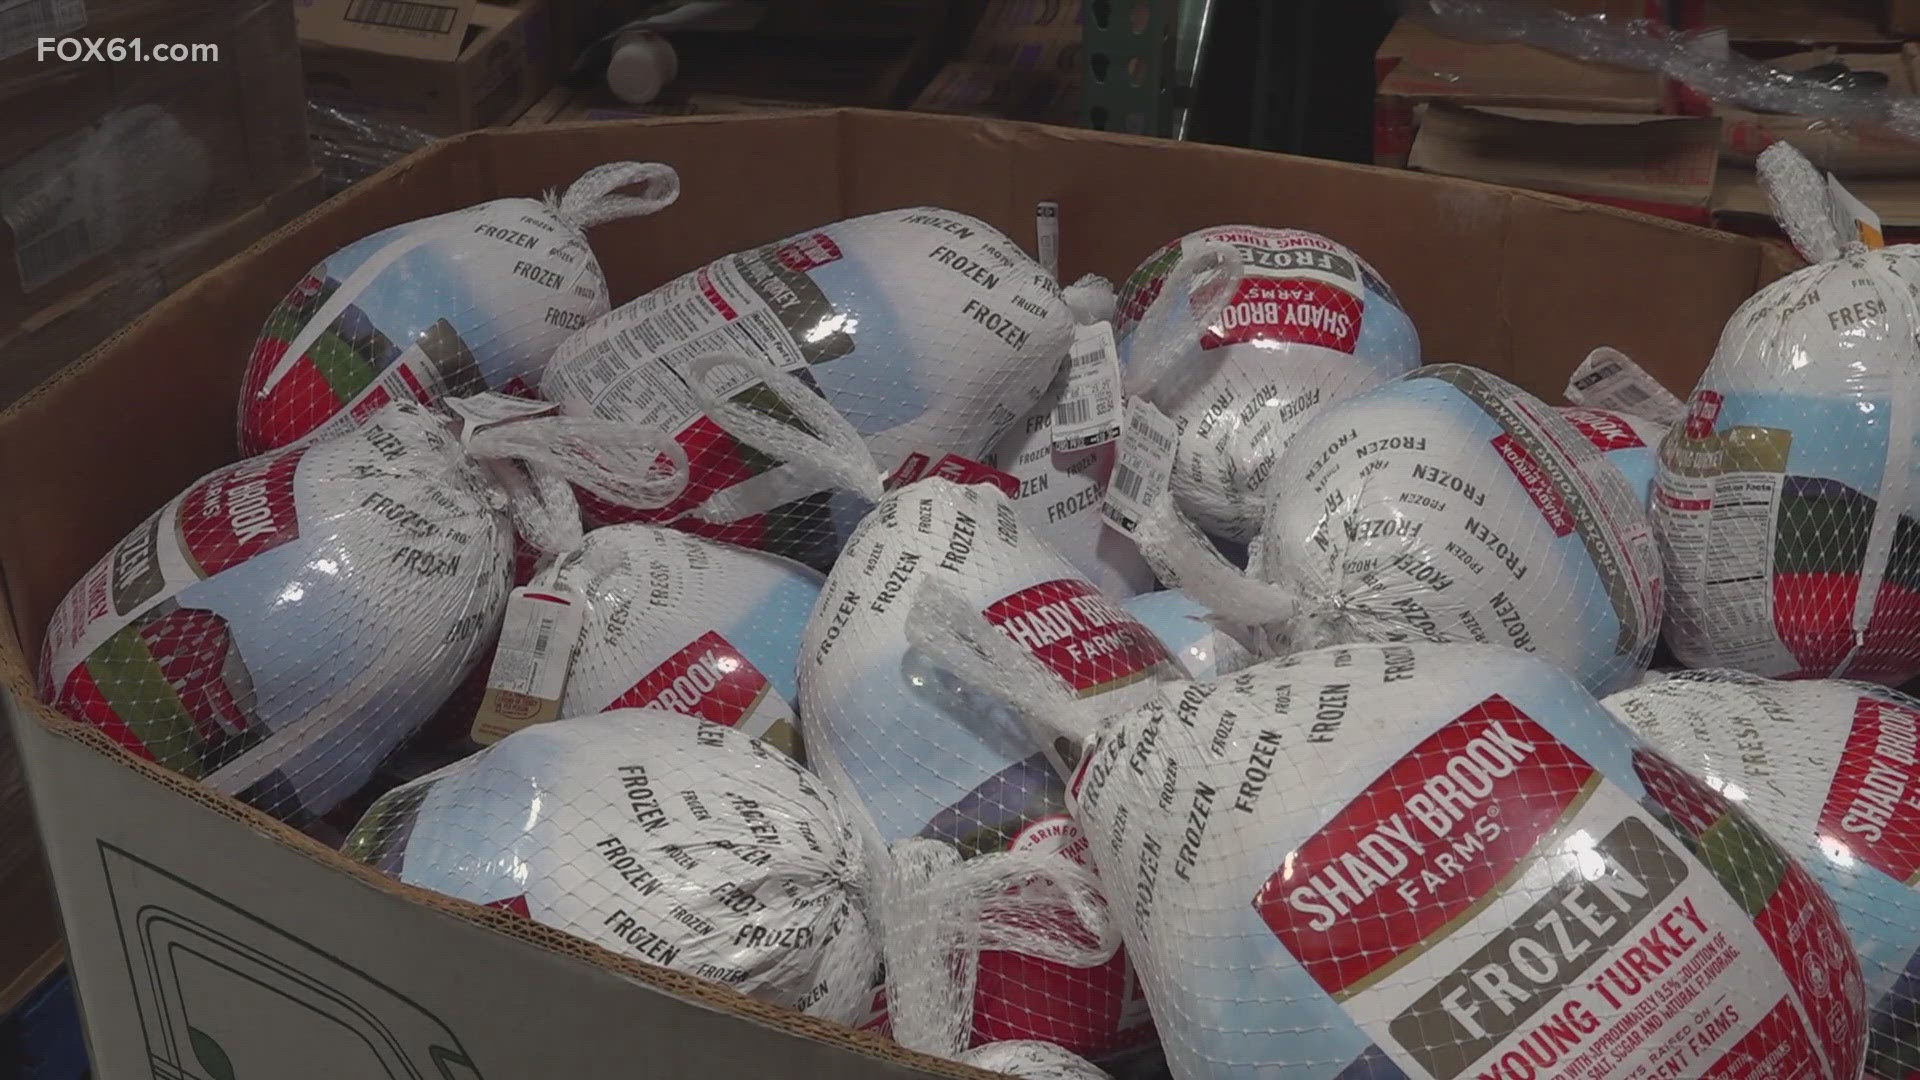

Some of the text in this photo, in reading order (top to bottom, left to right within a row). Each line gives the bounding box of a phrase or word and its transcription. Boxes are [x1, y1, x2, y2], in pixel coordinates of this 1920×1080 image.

[473, 224, 540, 250] FROZEN
[1240, 250, 1333, 269] FROZE
[513, 260, 565, 290] FROZEN
[928, 246, 1000, 291] FROZEN
[962, 299, 1031, 352] FROZEN
[1221, 301, 1350, 339] SHADY BROO
[1827, 299, 1887, 331] FRESH
[1240, 384, 1277, 426] FROZEN
[1305, 428, 1358, 482] FROZEN
[1356, 436, 1426, 459] FROZEN
[1047, 484, 1103, 524] FROZEN
[1412, 464, 1486, 507] FROZEN
[1500, 443, 1565, 529] SHADY BROOK
[227, 488, 278, 546] BROOK
[939, 511, 978, 573] FROZEN
[1445, 540, 1484, 575] FROZEN
[1464, 516, 1527, 580] FROZEN
[871, 552, 919, 616] FROZEN
[816, 590, 860, 666] FROZEN
[1489, 591, 1537, 653] FROZEN
[1211, 709, 1238, 758] FROZEN
[1306, 684, 1351, 744] FROZEN
[1235, 729, 1283, 815] FROZEN
[1727, 715, 1770, 777] FRESH
[1840, 704, 1919, 844] SHADY BROOK
[618, 764, 670, 833] FROZEN
[1288, 720, 1536, 933] SHADY BROOK
[1175, 780, 1216, 884] FROZEN
[596, 836, 664, 897] FROZEN
[604, 908, 682, 967] FROZEN
[669, 902, 715, 937] FROZEN
[1440, 848, 1649, 1041] FROZEN
[1476, 1000, 1601, 1080] YOUNG
[1587, 896, 1708, 1011] TURKEY
[1564, 931, 1728, 1080] WITH APPROXIMATELY 9.5% SOLUTION OF
[1611, 1027, 1645, 1063] SUGAR
[1640, 1013, 1664, 1039] AND
[1661, 983, 1701, 1022] NATURAL
[1648, 1025, 1691, 1064] RAISED
[1694, 1007, 1711, 1026] ON
[1687, 1004, 1740, 1058] FARMS
